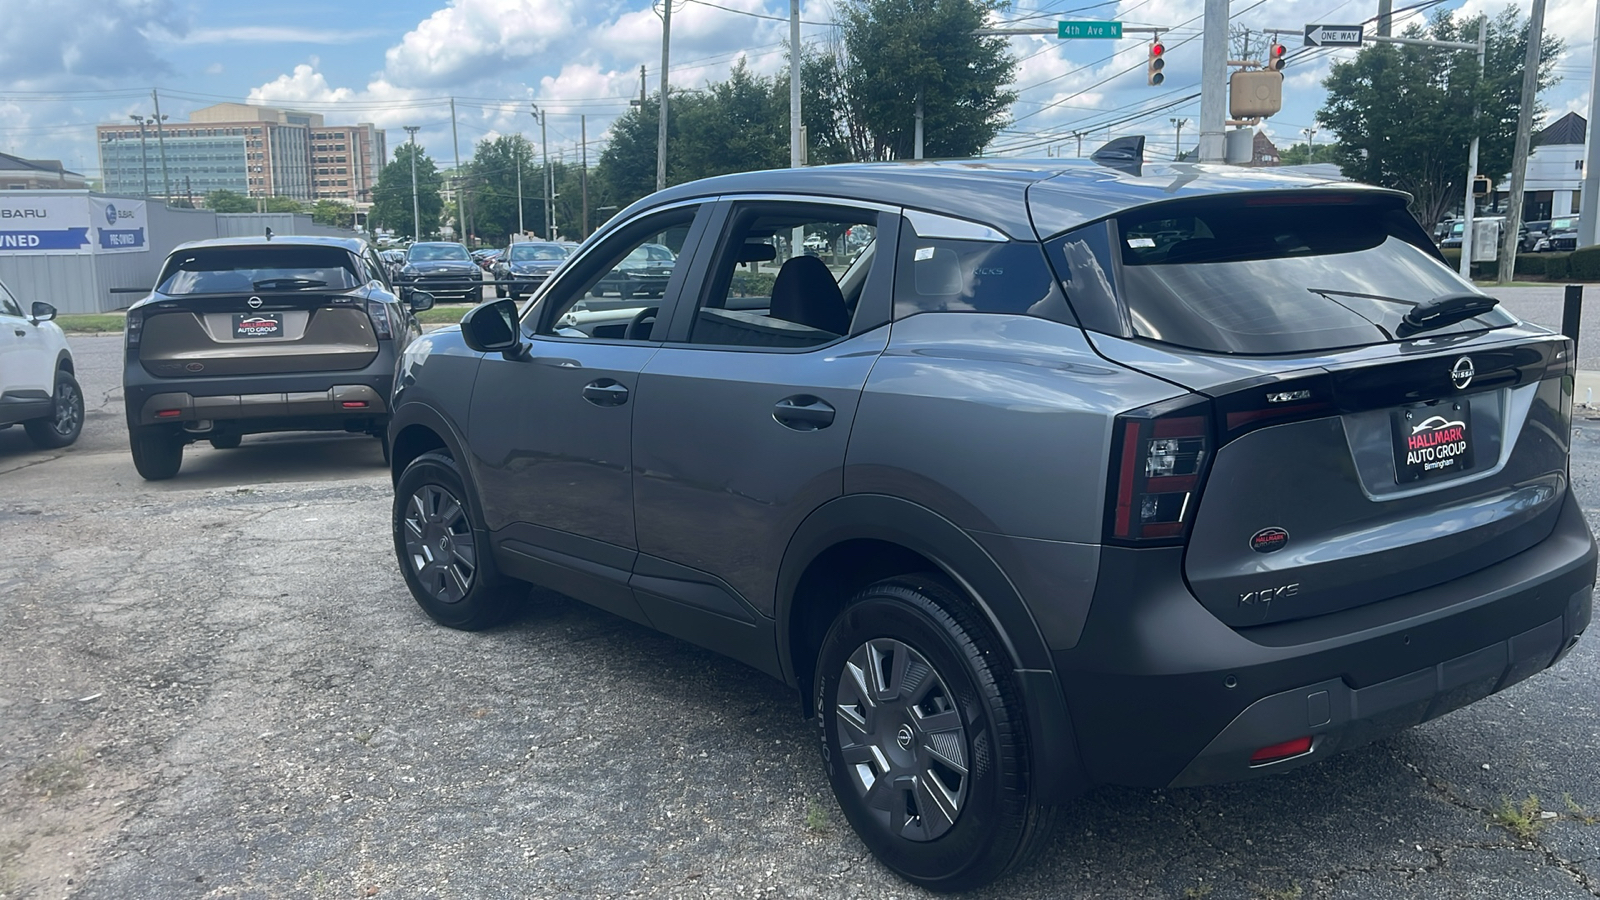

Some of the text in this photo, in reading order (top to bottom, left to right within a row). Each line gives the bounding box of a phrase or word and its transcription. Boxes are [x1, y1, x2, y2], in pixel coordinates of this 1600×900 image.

[1064, 25, 1117, 35] 4th Ave N
[1321, 31, 1357, 40] ONE WAY
[1407, 427, 1463, 450] HALLMARK
[1406, 441, 1467, 465] AUTO GROUP
[1424, 458, 1454, 471] Birmingham
[1255, 533, 1284, 543] HALLMARK
[1238, 583, 1300, 608] KICKS
